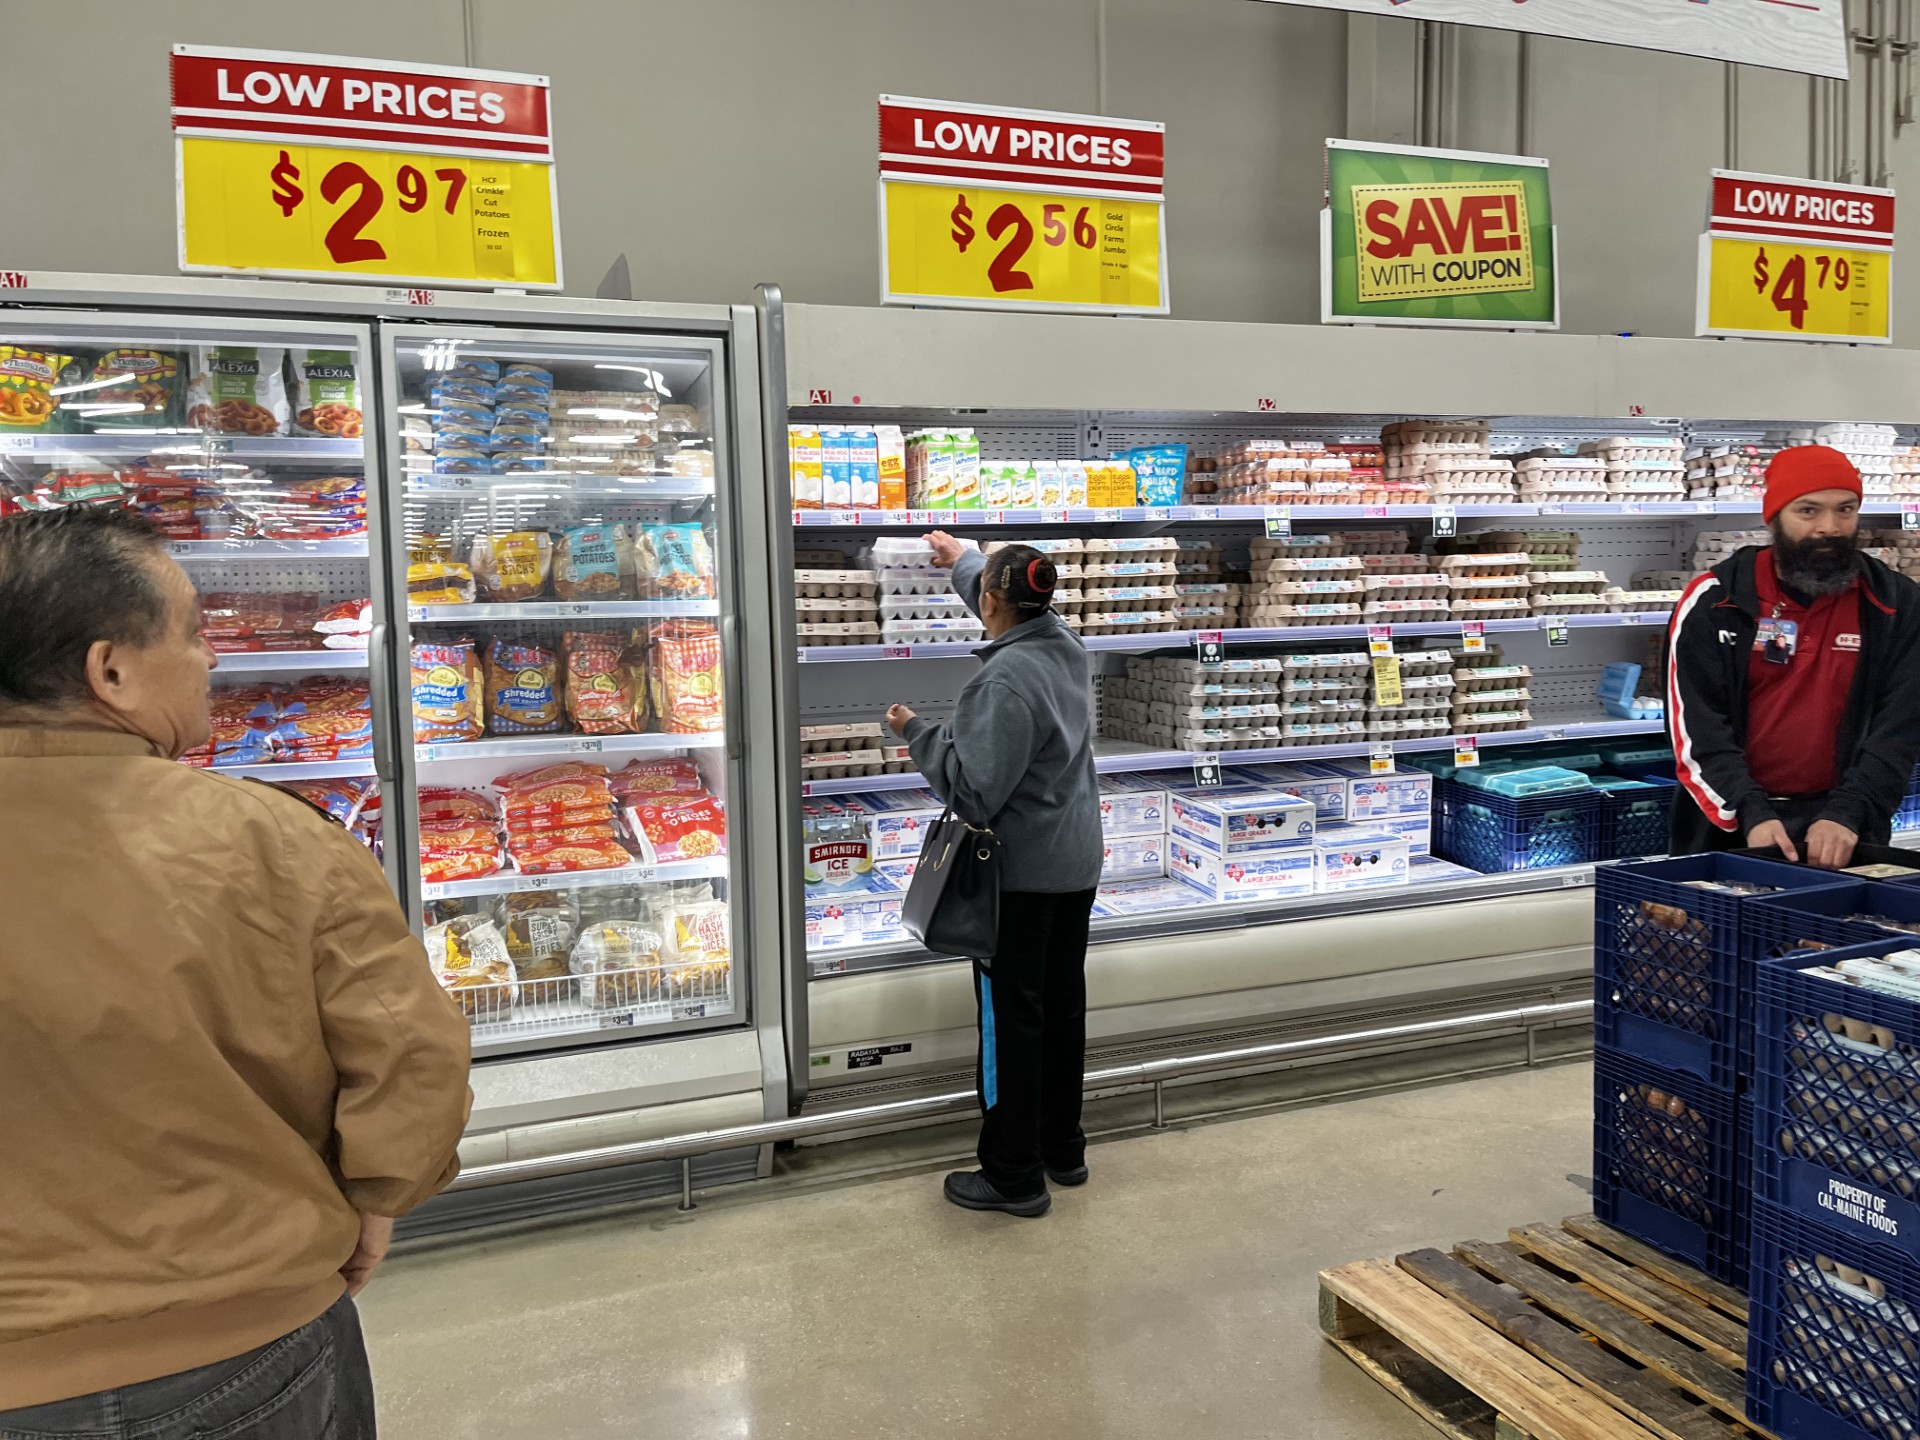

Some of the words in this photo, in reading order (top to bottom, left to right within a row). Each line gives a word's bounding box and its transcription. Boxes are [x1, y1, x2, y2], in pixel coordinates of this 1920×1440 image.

[217, 69, 330, 108] LOW
[343, 78, 506, 125] PRICES
[914, 118, 1000, 155] LOW
[1009, 127, 1132, 167] PRICES
[476, 186, 504, 195] Crinkle
[483, 198, 498, 206] Cut
[1734, 188, 1790, 216] LOW
[1795, 194, 1874, 226] PRICES
[474, 209, 510, 219] Potatoes
[1106, 213, 1123, 221] Gold
[477, 227, 510, 238] Frozen
[1104, 223, 1124, 232] Circle
[1365, 194, 1522, 260] SAVE!
[1104, 234, 1125, 243] Farms
[1103, 246, 1127, 254] Jumbo
[1370, 263, 1426, 287] WITH
[1432, 257, 1521, 283] COUPON
[0, 272, 26, 289] A17
[409, 289, 434, 305] A18
[212, 363, 256, 374] ALEXIA
[308, 368, 351, 378] ALEXIA
[810, 390, 830, 404] A1
[1259, 398, 1276, 410] A2
[881, 457, 899, 469] egg
[572, 552, 616, 565] POTATOES
[501, 563, 536, 576] STICKS
[414, 684, 458, 698] Shredded
[504, 689, 546, 699] Shredded
[814, 845, 863, 859] SMIRNOFF
[827, 859, 849, 871] ICE
[825, 870, 851, 879] ORIGINAL
[1266, 874, 1286, 882] GRADE
[698, 921, 724, 934] HASH
[534, 941, 562, 956] FRIES
[701, 938, 727, 952] DICES
[850, 1049, 880, 1058] RADA13A
[1828, 1179, 1873, 1209] PROPERTY
[1873, 1196, 1887, 1214] OF
[1818, 1191, 1865, 1224] CAL-MAINE
[1866, 1211, 1898, 1236] FOODS
